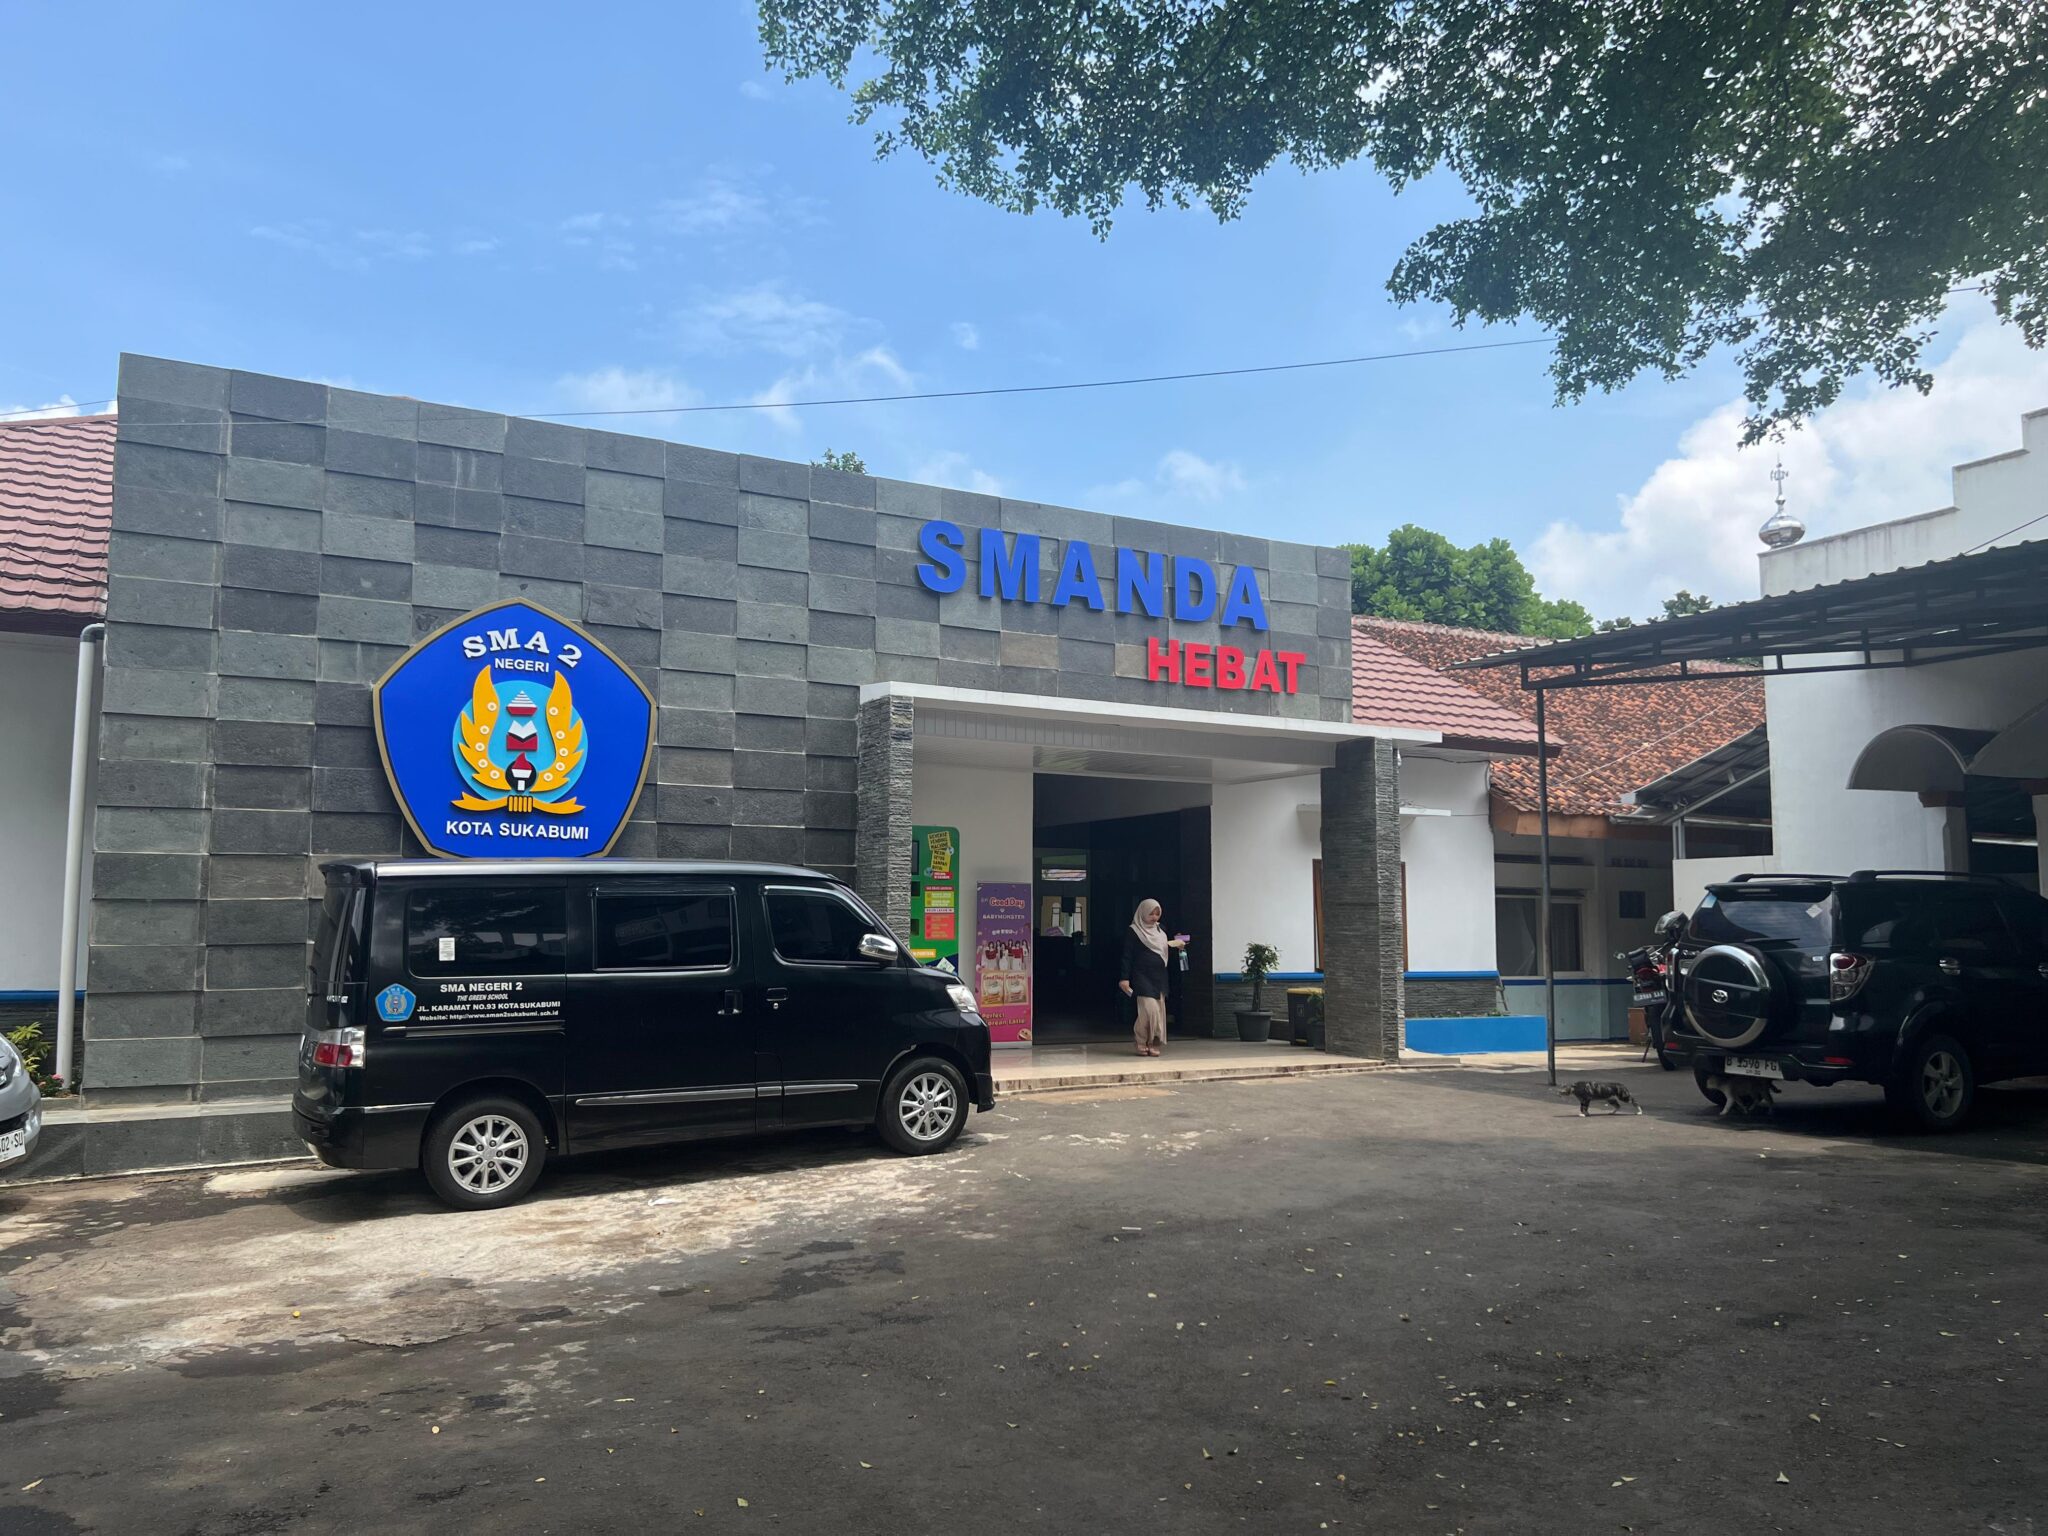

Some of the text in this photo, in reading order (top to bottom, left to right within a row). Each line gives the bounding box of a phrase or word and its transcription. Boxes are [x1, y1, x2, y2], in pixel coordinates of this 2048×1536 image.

[916, 519, 1270, 631] SMANDA
[462, 627, 583, 668] SMA 2
[494, 657, 549, 673] NEGERI
[1147, 636, 1307, 694] HEBAT
[446, 820, 589, 840] KOTA SUKABUMI
[440, 981, 523, 993] SMA NEGERI 2
[487, 993, 509, 1001] SCHOOL
[431, 1004, 472, 1012] KARAMAT
[520, 1001, 561, 1009] SUKABUMI
